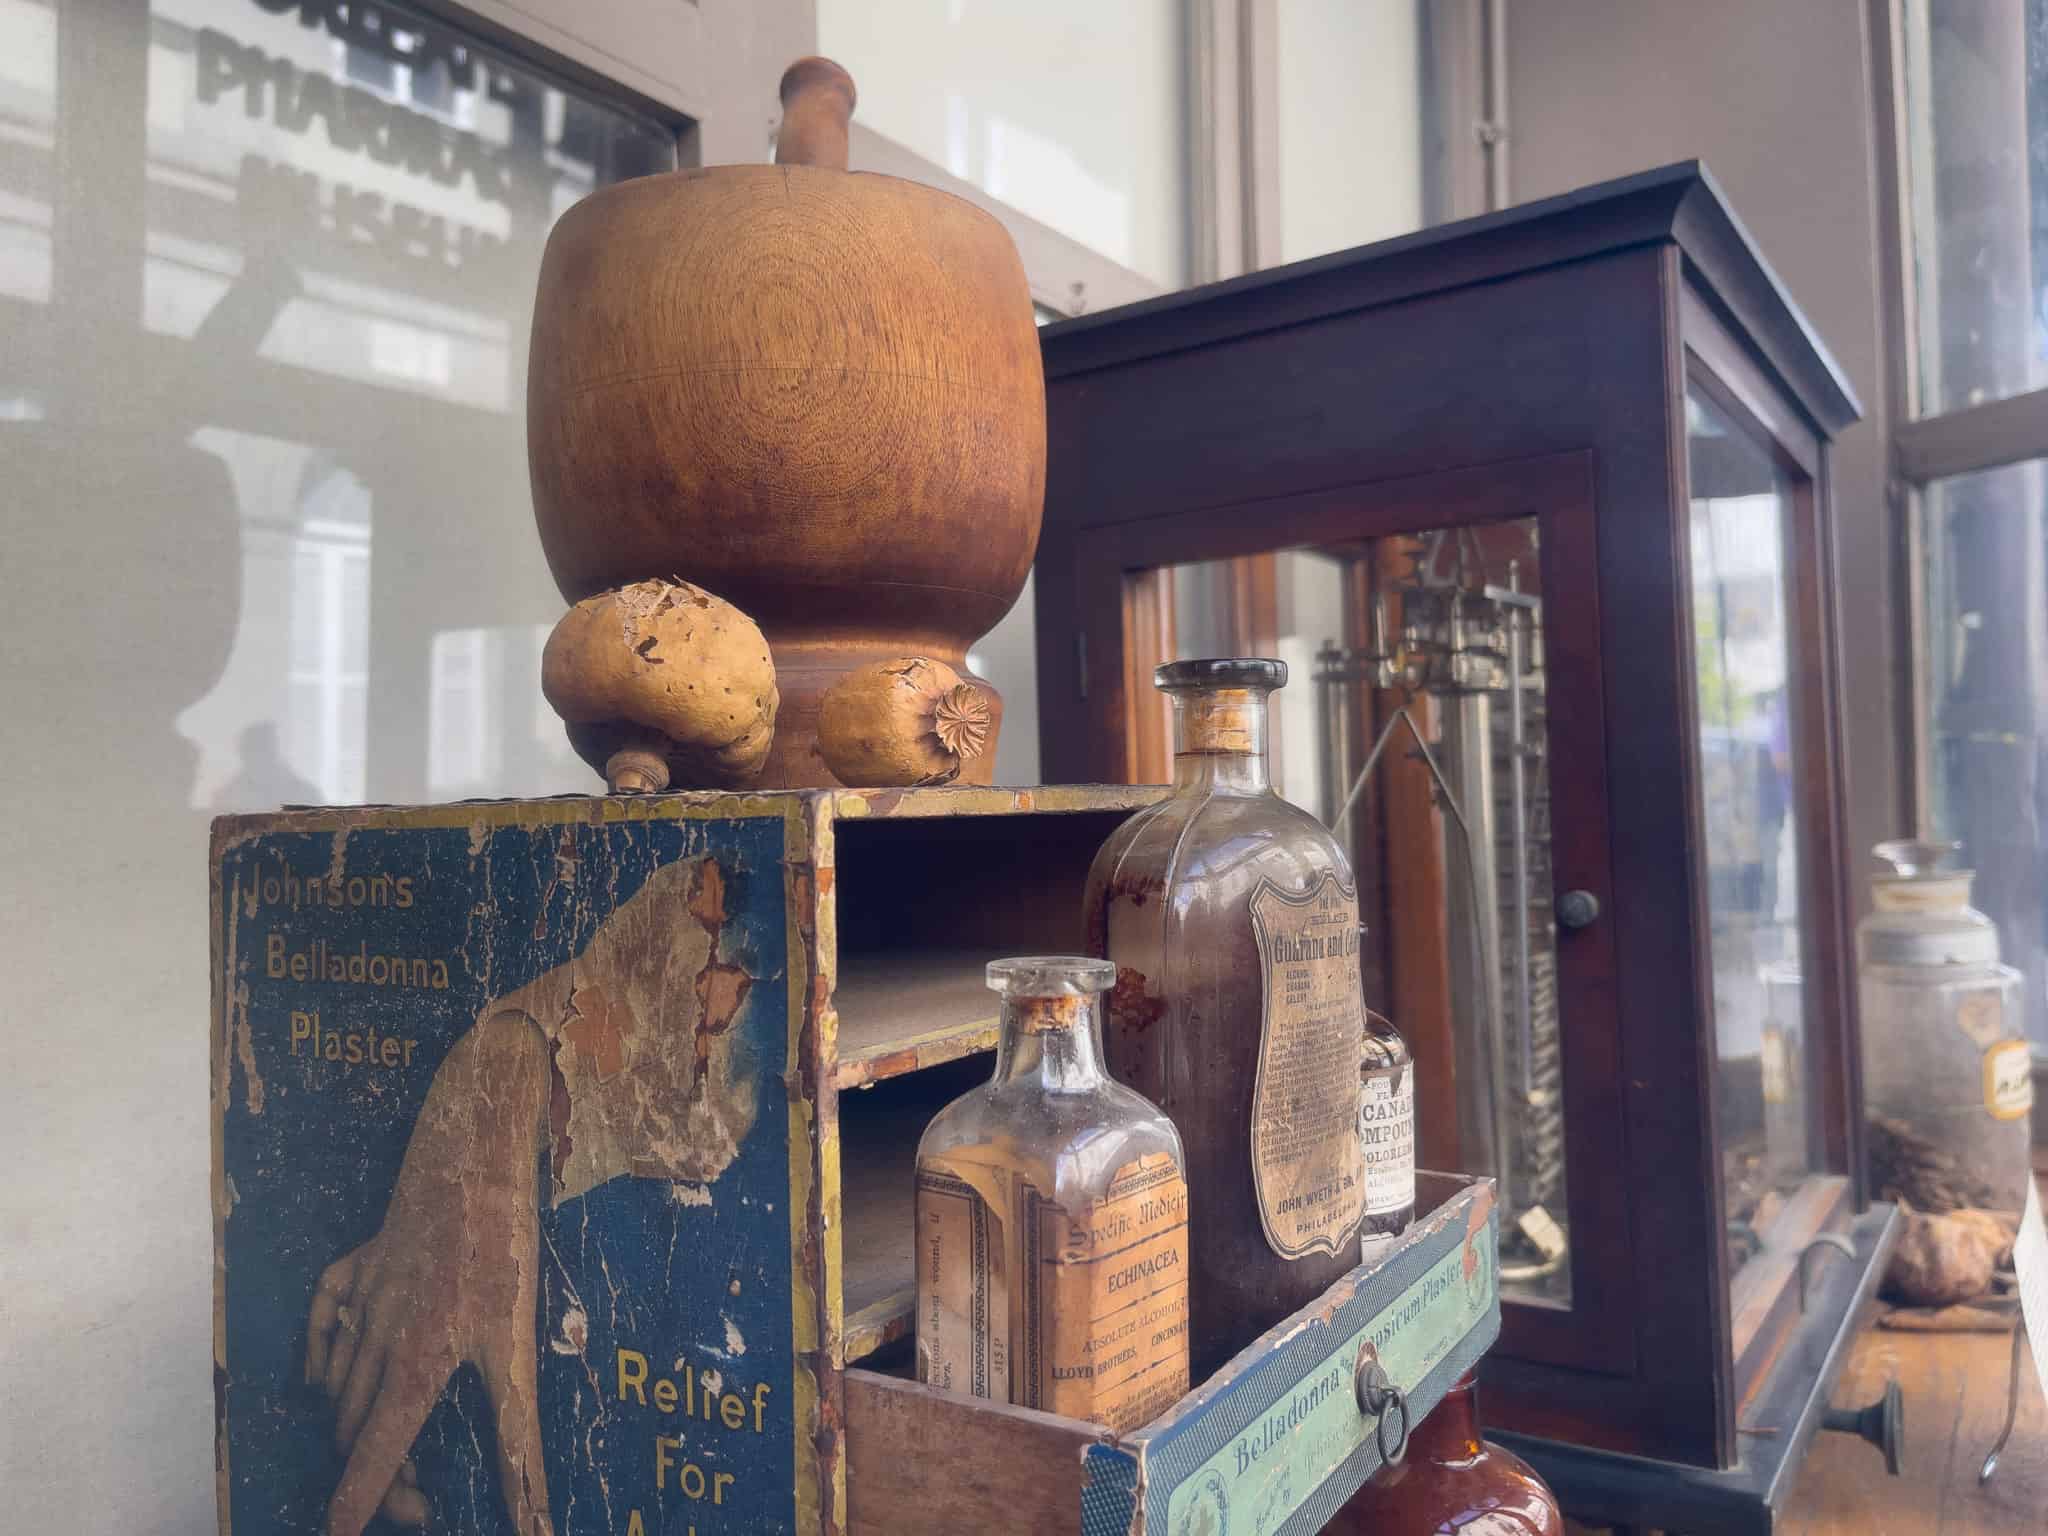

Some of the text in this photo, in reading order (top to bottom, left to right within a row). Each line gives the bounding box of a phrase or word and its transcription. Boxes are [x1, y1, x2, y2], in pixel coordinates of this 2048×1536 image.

[265, 934, 450, 990] Belladonna
[290, 1011, 418, 1068] Plaster
[1277, 1196, 1302, 1216] JOHN
[1306, 1187, 1333, 1206] WYETH
[1107, 1247, 1180, 1293] ECHINACEA
[616, 1349, 772, 1433] Relief
[1051, 1365, 1095, 1380] LLOYD
[1233, 1366, 1341, 1478] Belladonna
[655, 1434, 735, 1505] For
